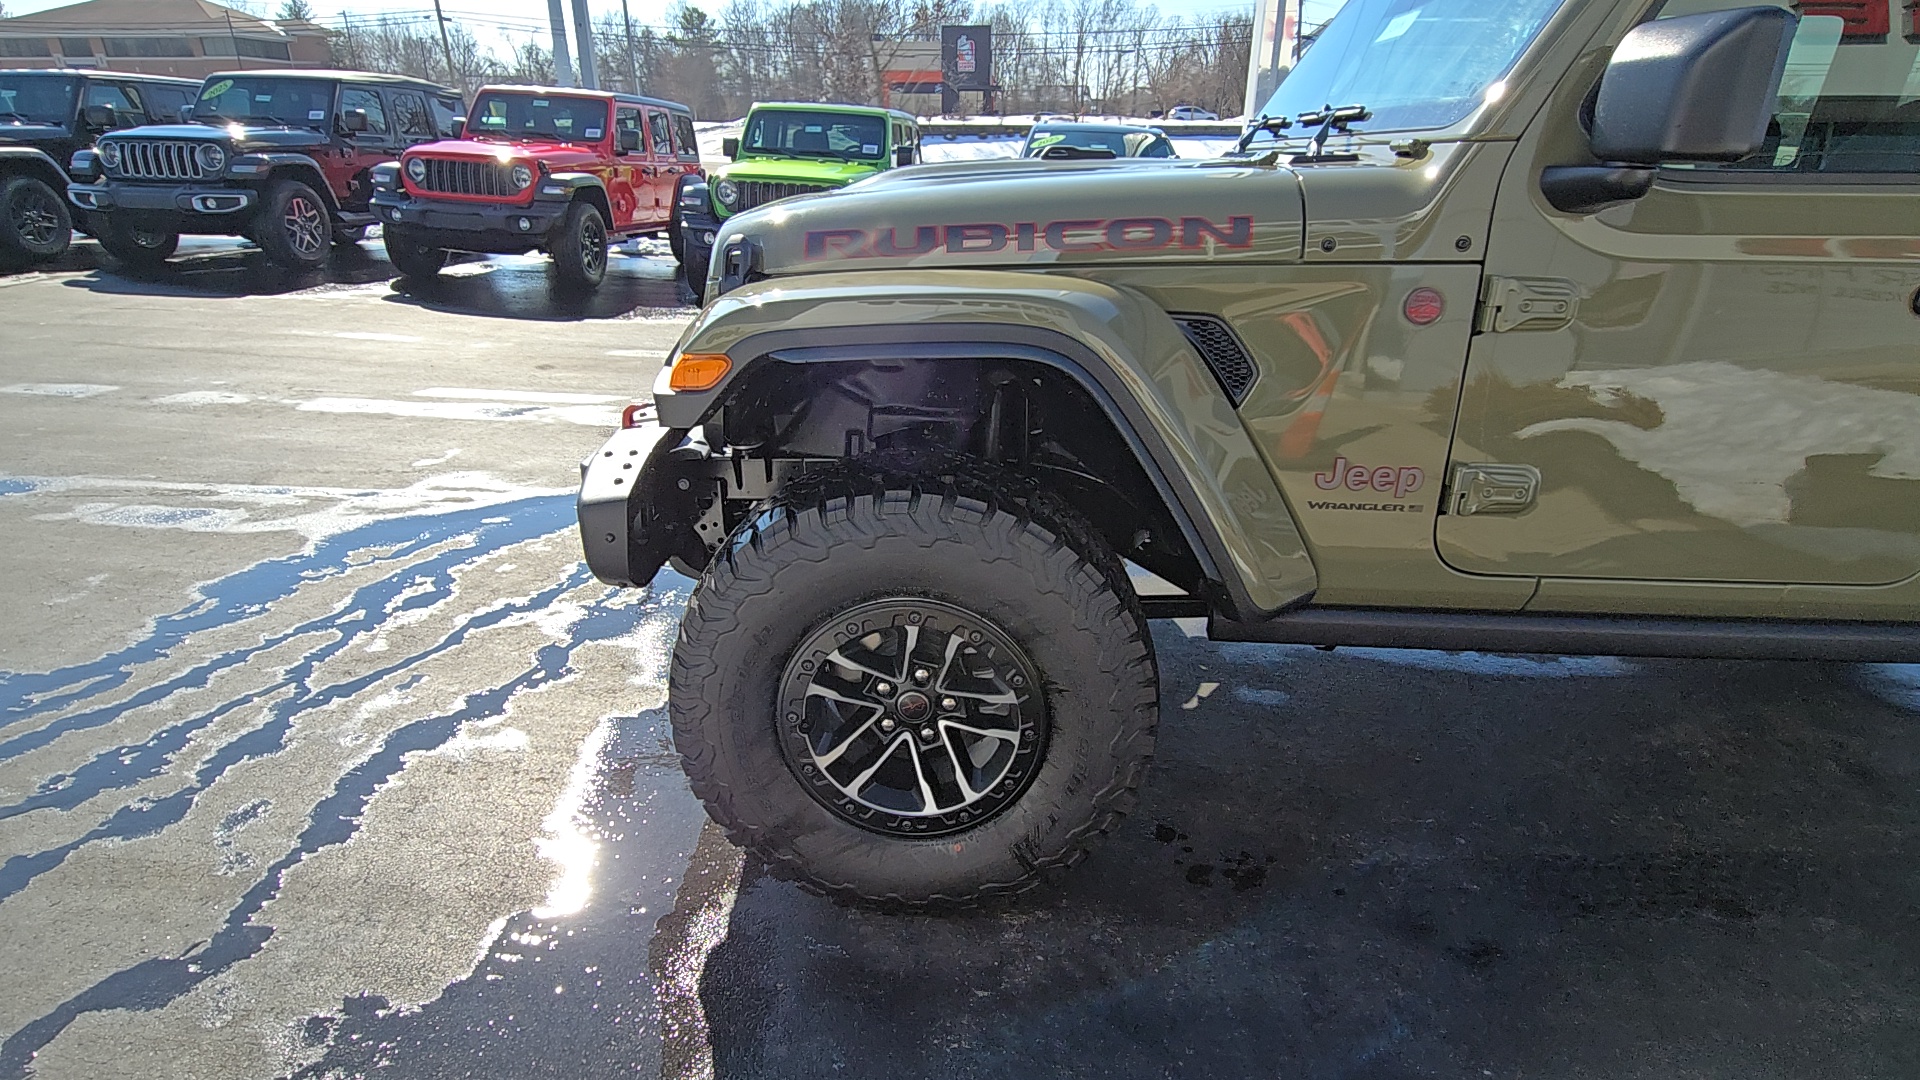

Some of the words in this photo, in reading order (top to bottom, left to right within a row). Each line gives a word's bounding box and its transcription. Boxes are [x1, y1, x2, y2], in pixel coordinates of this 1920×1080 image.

[803, 215, 1255, 261] RUBICON
[1315, 457, 1424, 499] Jeep
[1307, 500, 1406, 512] WRANGLER
